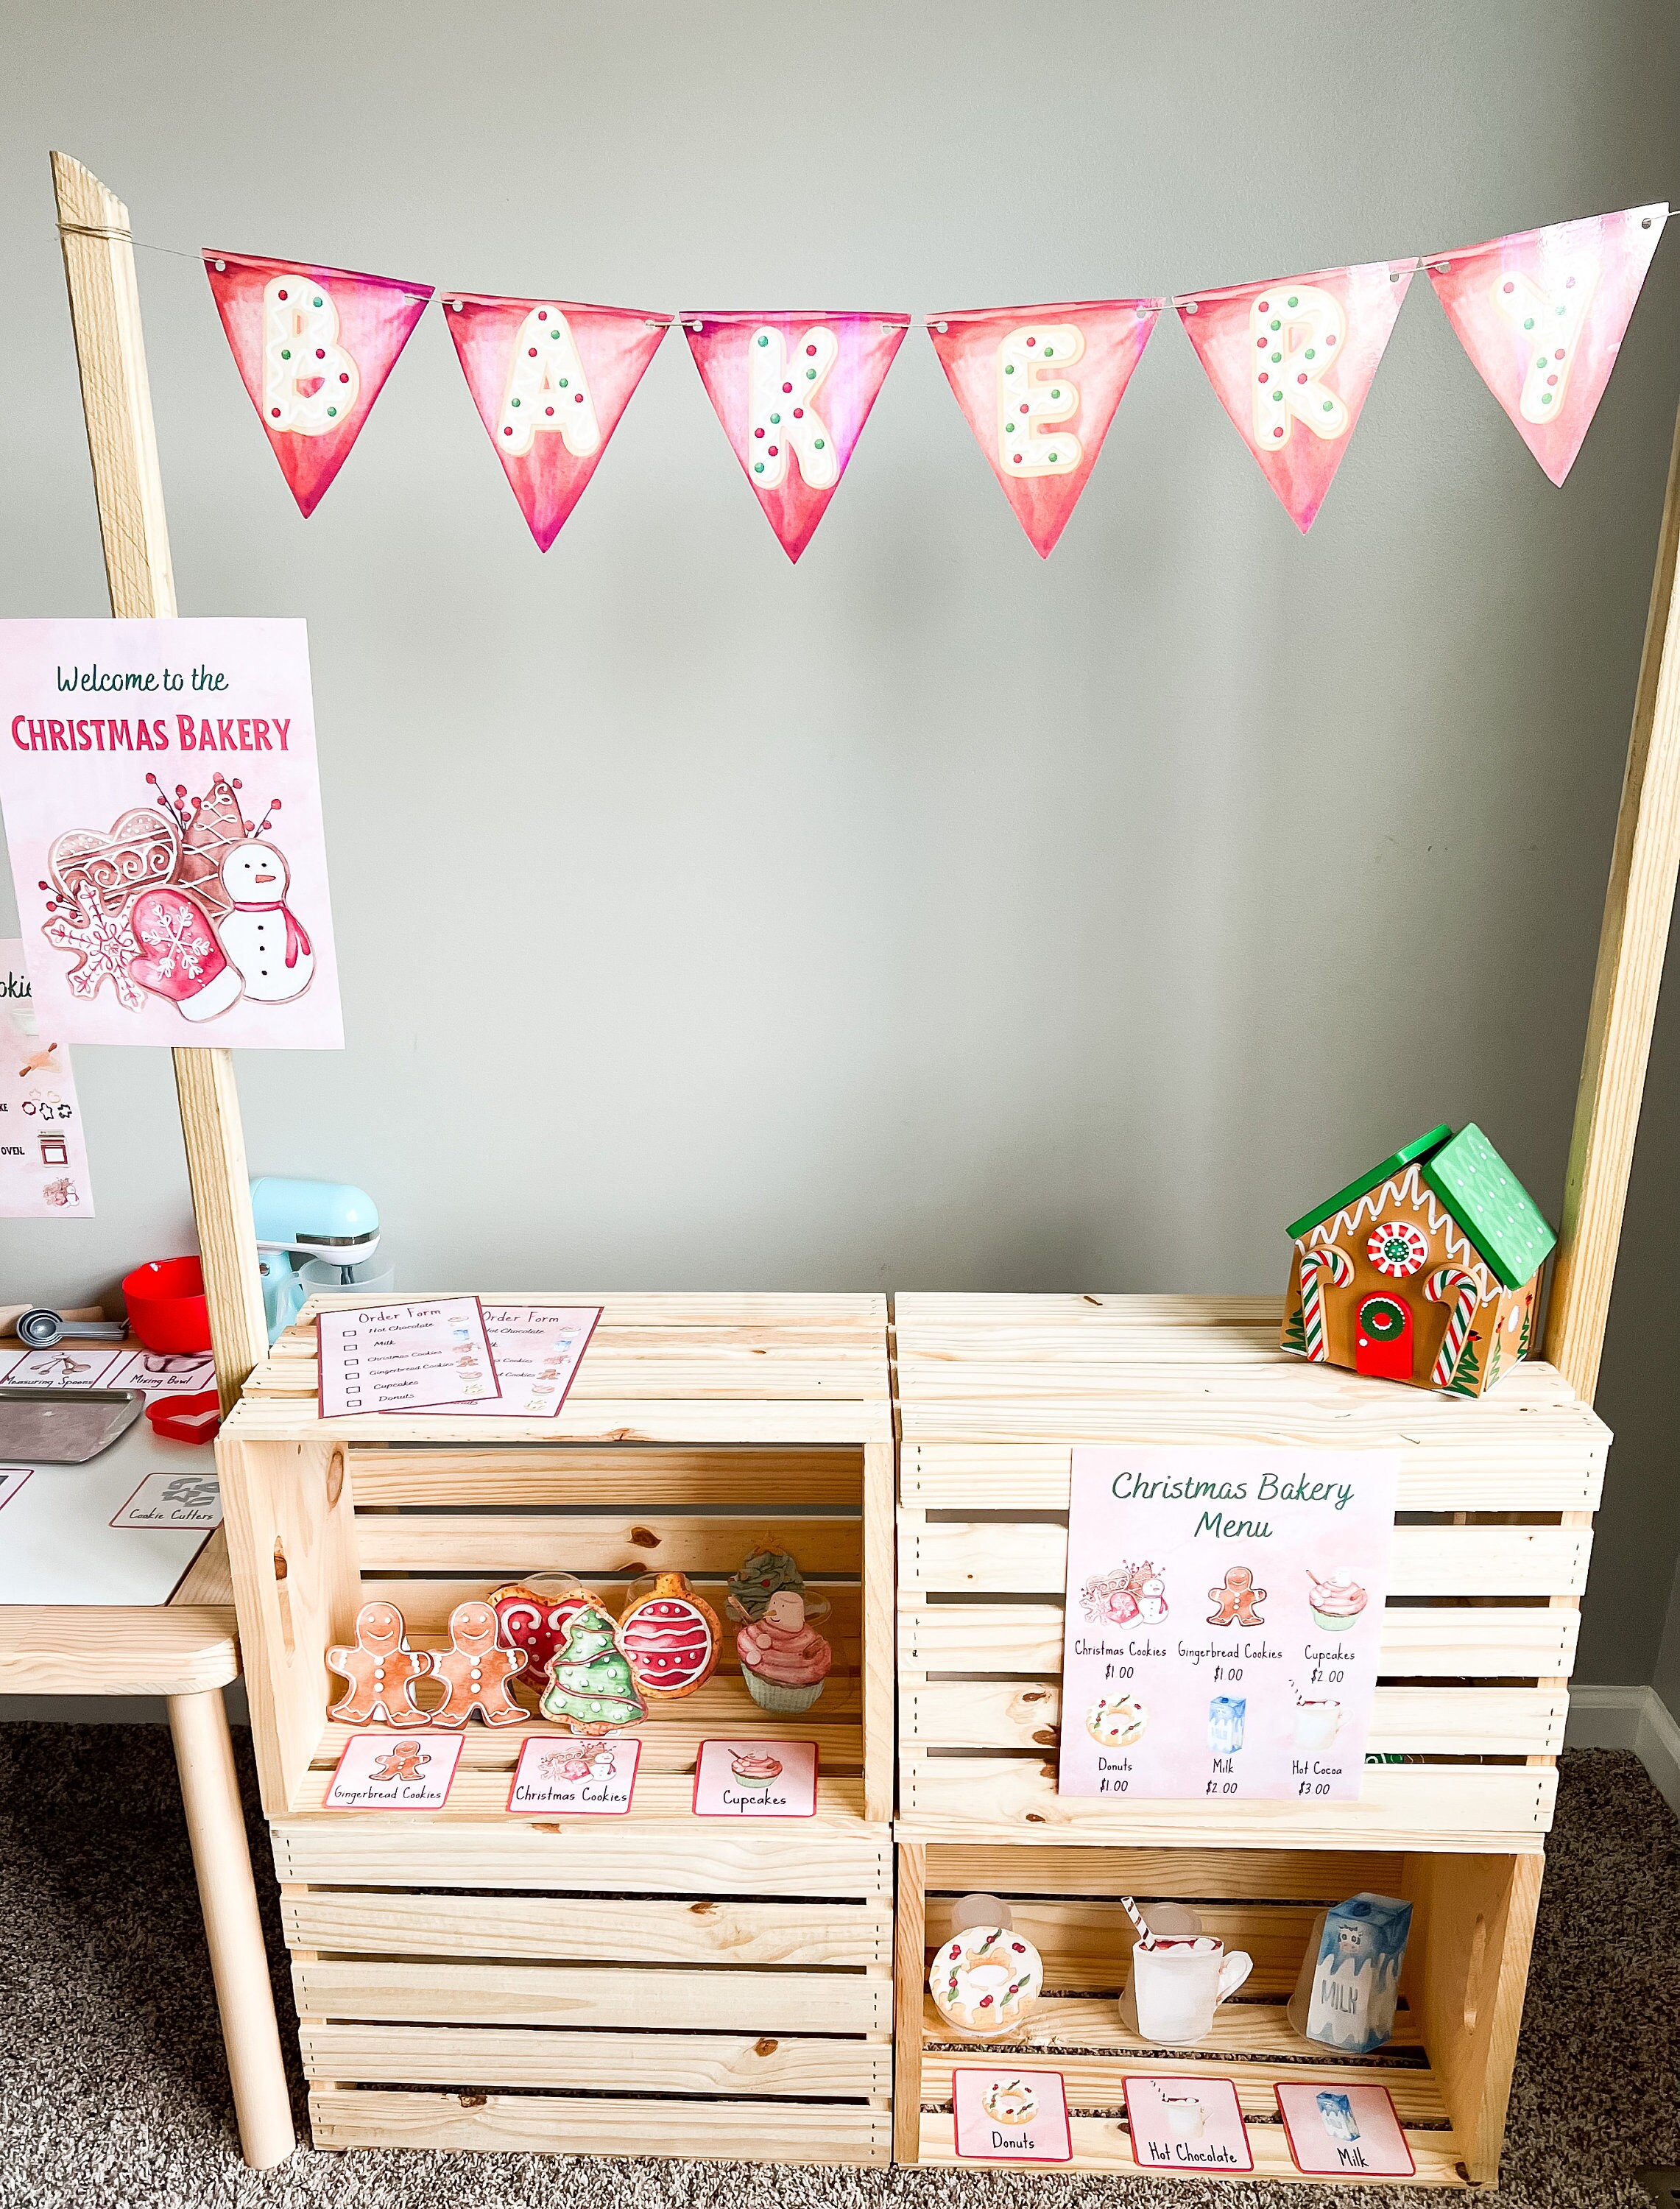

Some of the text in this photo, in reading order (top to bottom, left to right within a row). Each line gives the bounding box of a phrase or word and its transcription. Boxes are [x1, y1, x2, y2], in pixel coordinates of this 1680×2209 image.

[57, 664, 229, 691] Welcome to the
[12, 714, 292, 751] CHRISTMAS BAKERY
[359, 1307, 441, 1323] Order Form
[528, 1311, 559, 1322] Form
[389, 1322, 435, 1331] Chocolate
[370, 1366, 420, 1375] Gingerbread
[7, 1375, 93, 1388] Measuring Spoons
[130, 1374, 193, 1387] Mixing Bowl
[374, 1381, 419, 1389] Cupcakes
[1112, 1471, 1355, 1510] Christmas Bakery
[130, 1507, 213, 1520] Cookie Cutters
[1194, 1512, 1274, 1538] Menu
[1075, 1638, 1167, 1657] Christmas Cookies
[1178, 1641, 1282, 1665] Gingerbread Cookies
[1305, 1642, 1355, 1668] Cupcakes
[1098, 1758, 1133, 1772] Donuts
[1213, 1758, 1234, 1774] Milk
[1292, 1761, 1342, 1775] Hot Cocoa
[334, 1785, 441, 1804] Gingerbread Cookies
[516, 1785, 627, 1802] Christmas Cookies
[723, 1788, 786, 1813] Cupcakes
[1321, 1979, 1358, 2015] MILK
[992, 2131, 1035, 2149] Donuts
[1148, 2141, 1237, 2163] Hot Chocolate
[1337, 2146, 1369, 2167] Milk
